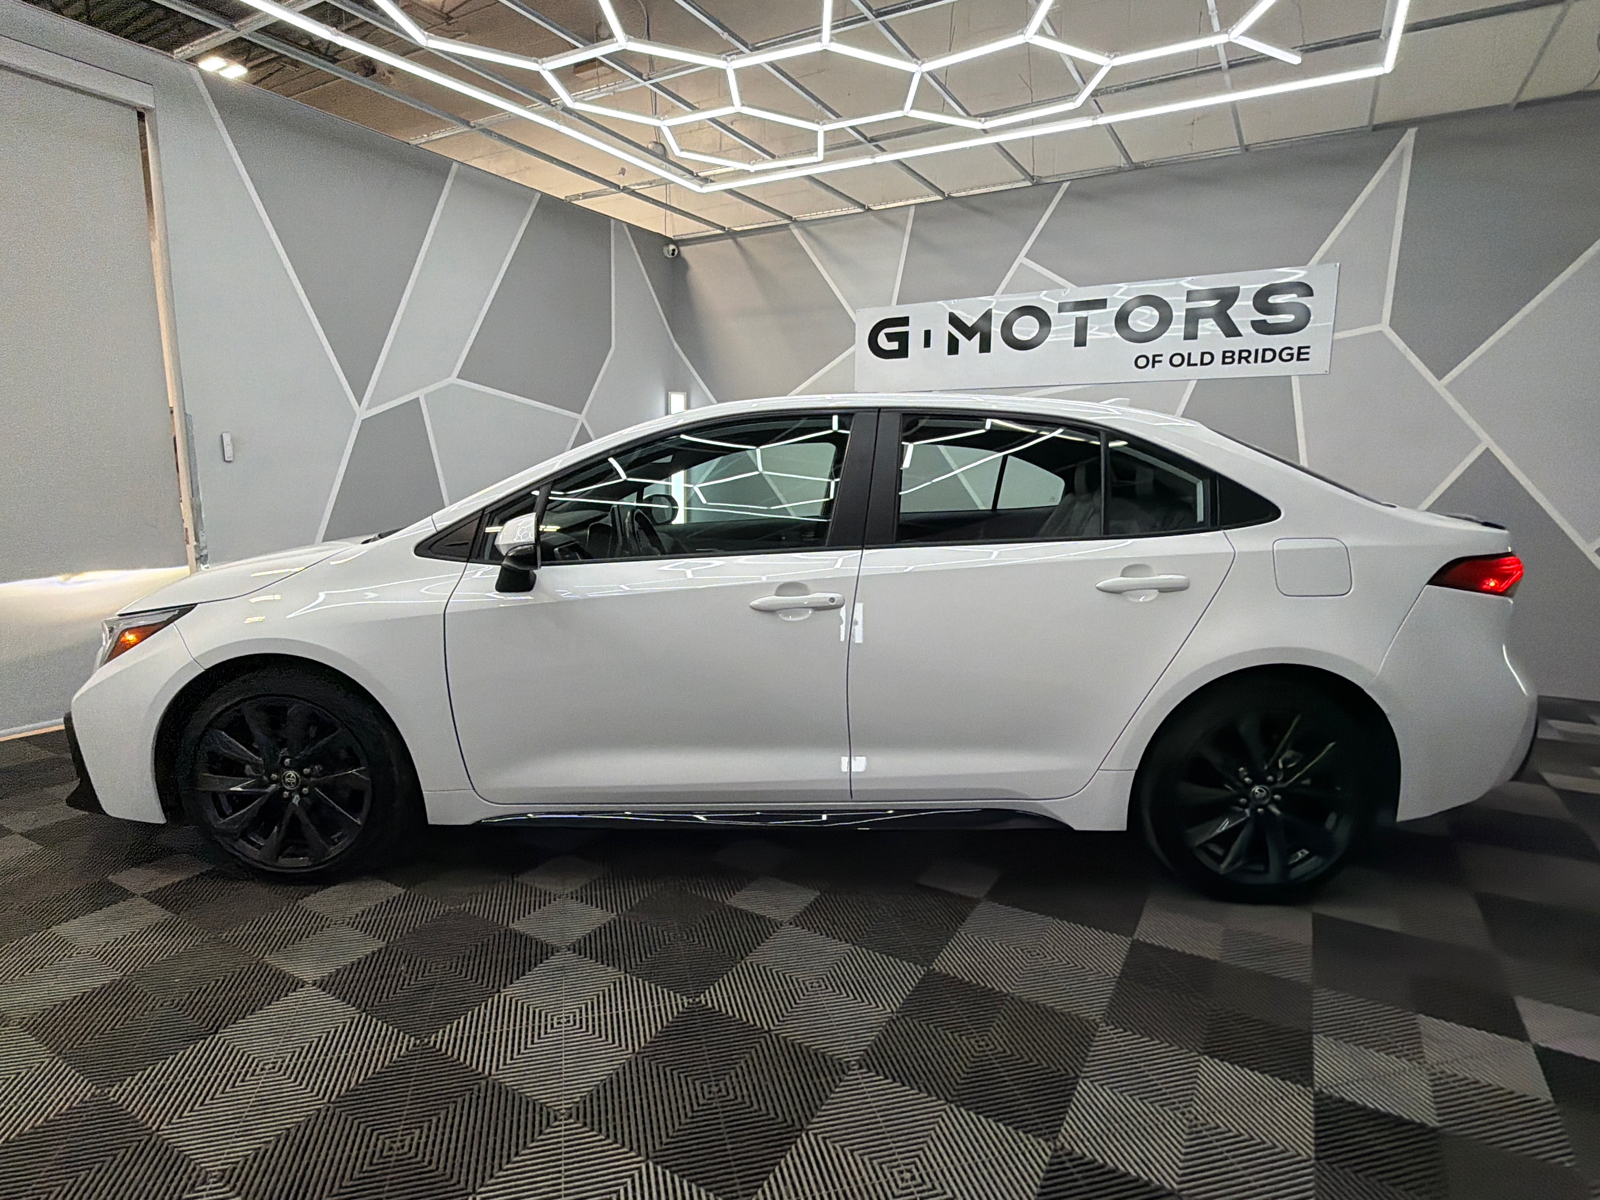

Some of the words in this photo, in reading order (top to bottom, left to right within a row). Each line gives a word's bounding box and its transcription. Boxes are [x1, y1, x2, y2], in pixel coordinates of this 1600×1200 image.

[1134, 353, 1164, 370] OF
[1168, 351, 1215, 368] OLD
[1221, 345, 1311, 366] BRIDGE
